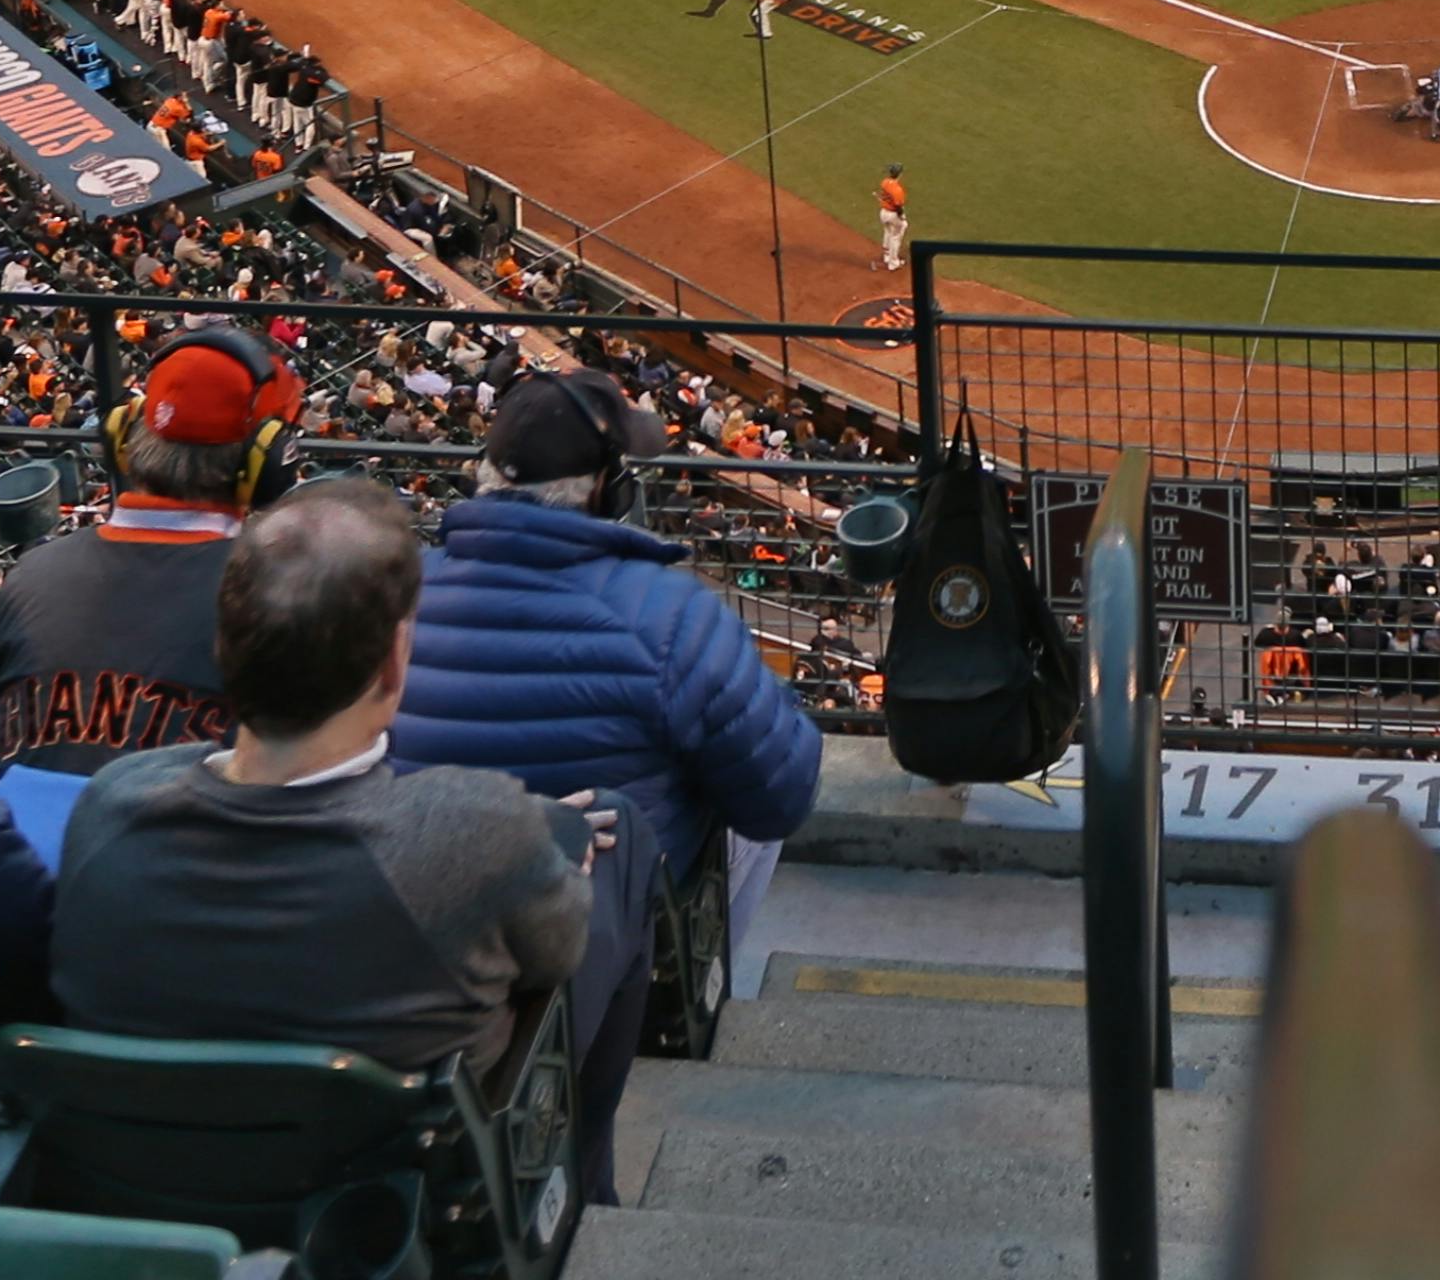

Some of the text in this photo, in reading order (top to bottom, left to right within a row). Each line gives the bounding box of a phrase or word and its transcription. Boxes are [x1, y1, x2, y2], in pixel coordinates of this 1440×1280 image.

[791, 5, 908, 54] DRIVE
[69, 152, 152, 207] GIANTS
[1075, 483, 1203, 509] PSE
[1177, 547, 1204, 563] ON
[1166, 583, 1212, 599] RAIL
[1162, 763, 1278, 820] 17
